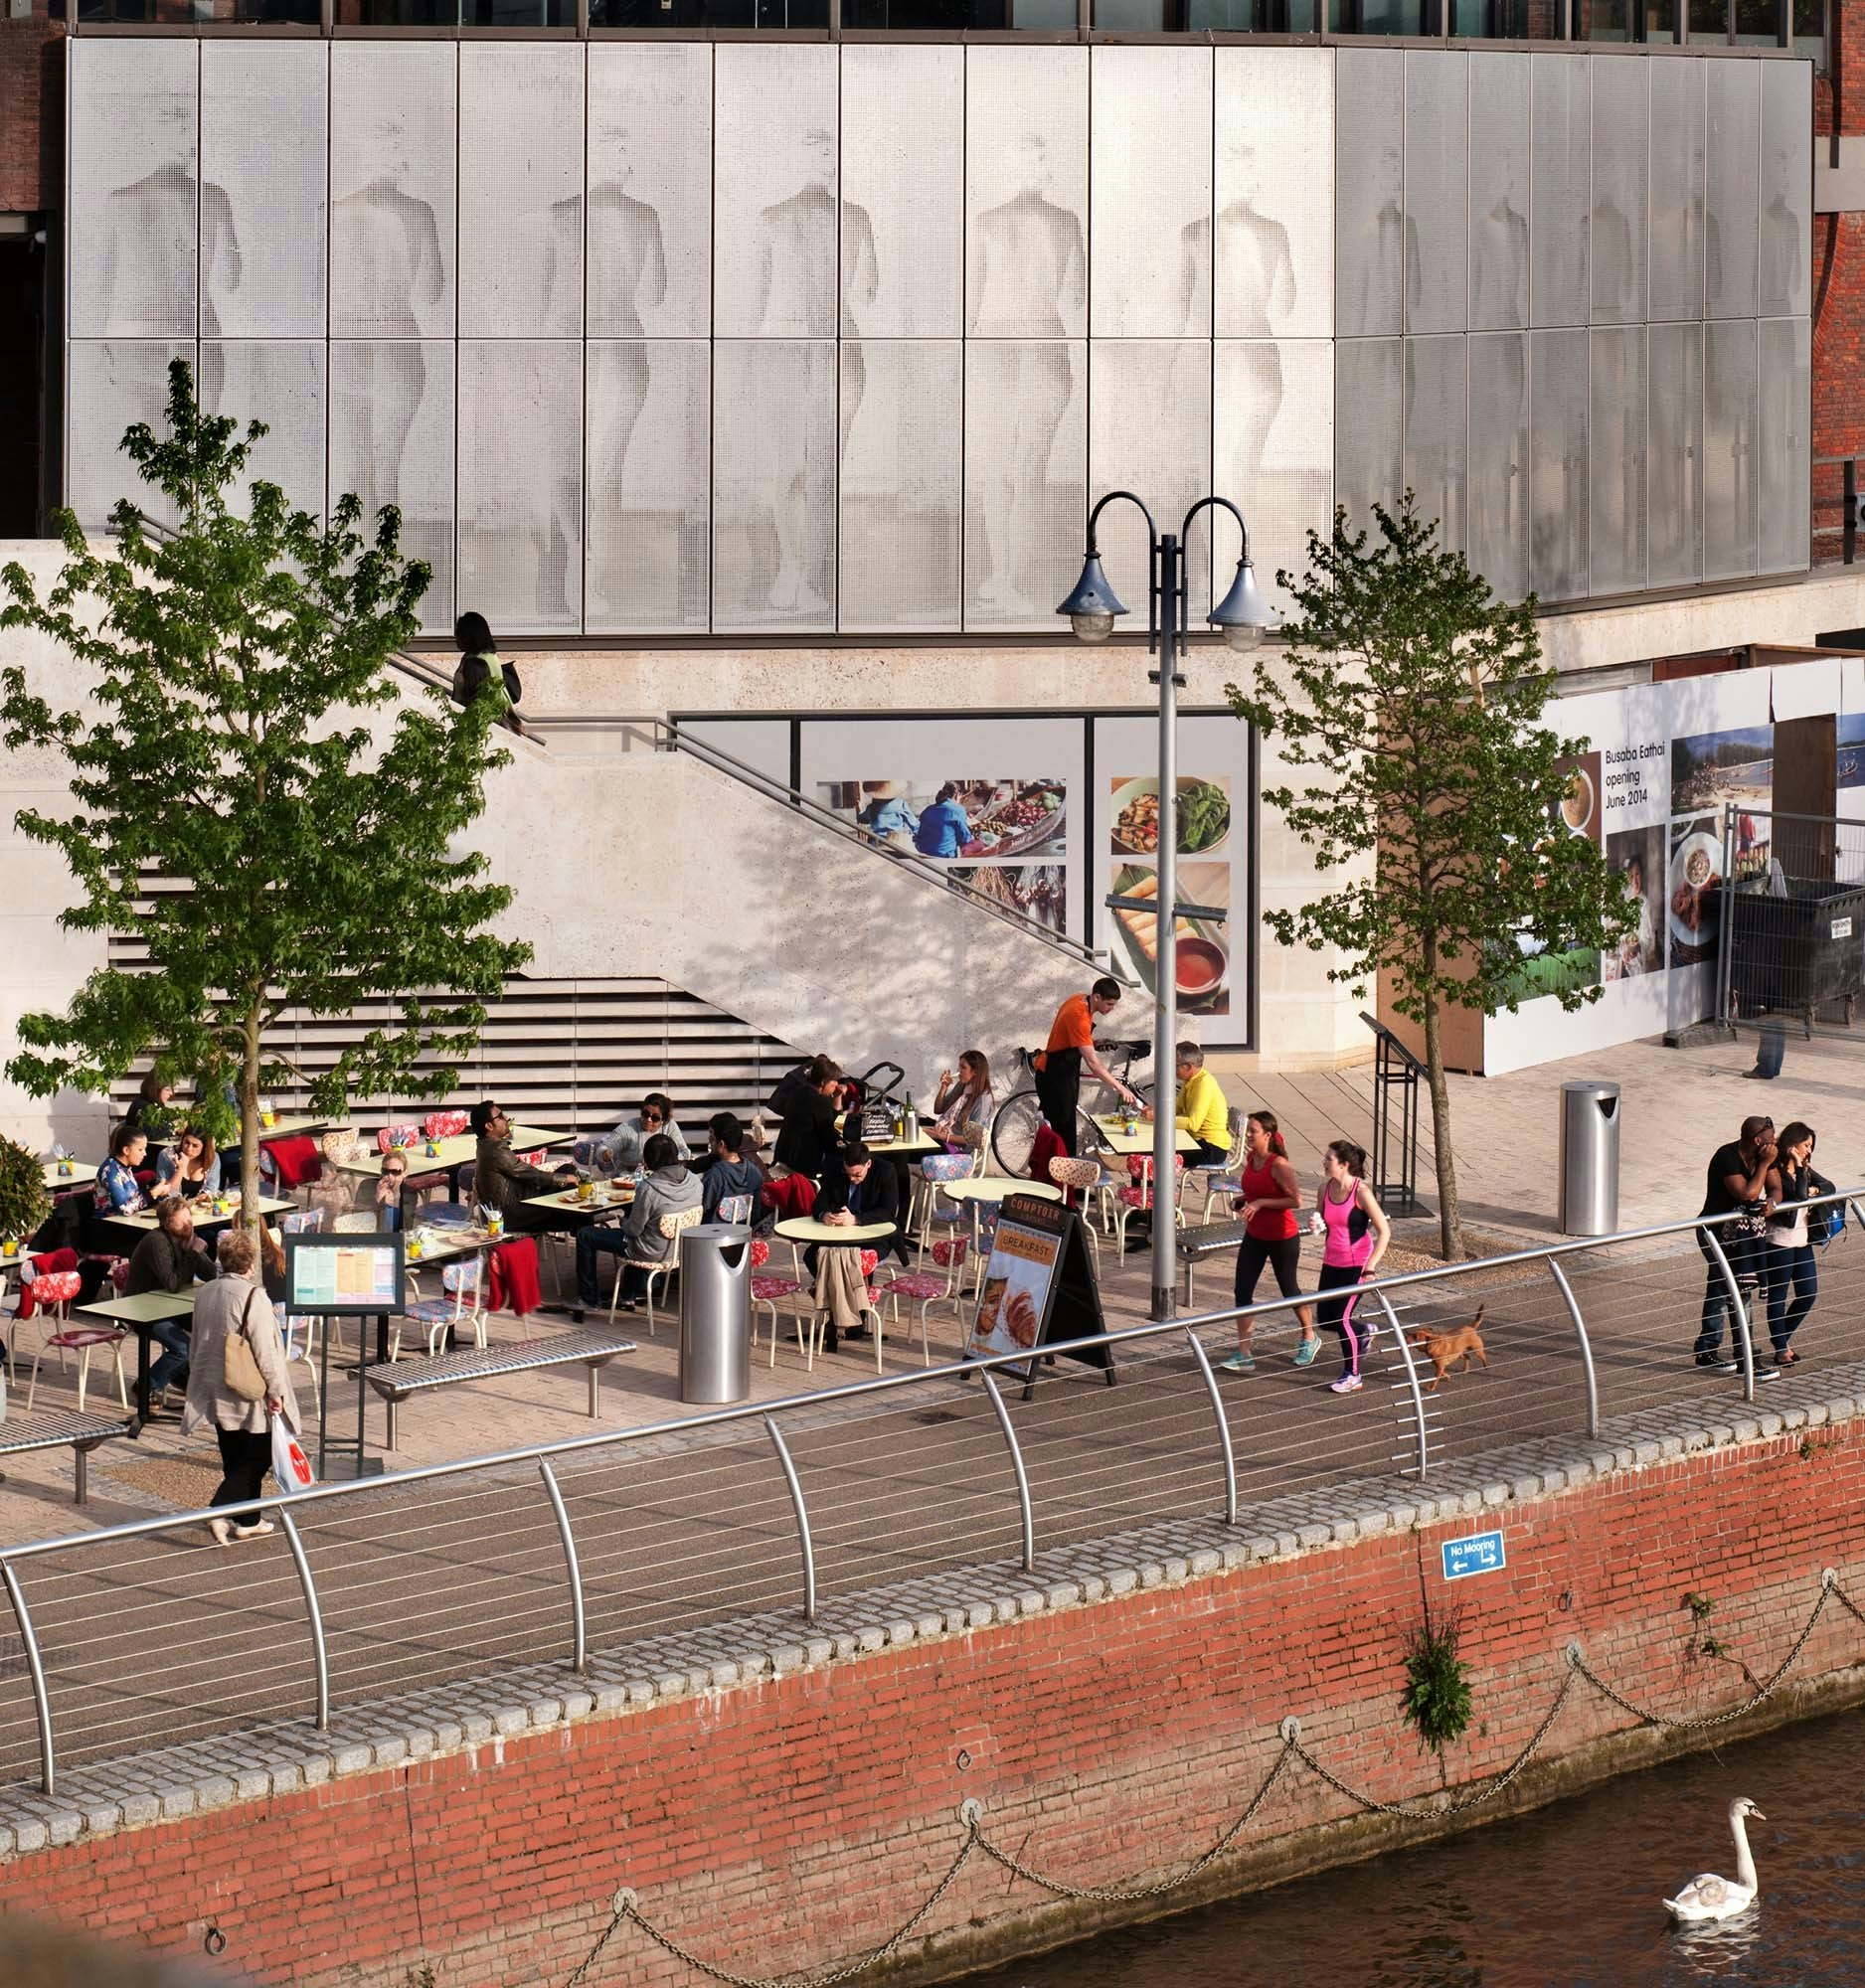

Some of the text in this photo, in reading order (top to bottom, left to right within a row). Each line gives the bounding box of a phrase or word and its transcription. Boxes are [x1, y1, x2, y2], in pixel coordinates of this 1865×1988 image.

[1606, 741, 1665, 763] Busaba Eathai
[1606, 768, 1640, 789] opening
[1606, 788, 1647, 809] June 2014
[1010, 1198, 1060, 1221] COMPTOIR
[1002, 1235, 1050, 1257] BREAKFAST
[1450, 1540, 1495, 1557] No Mooring
